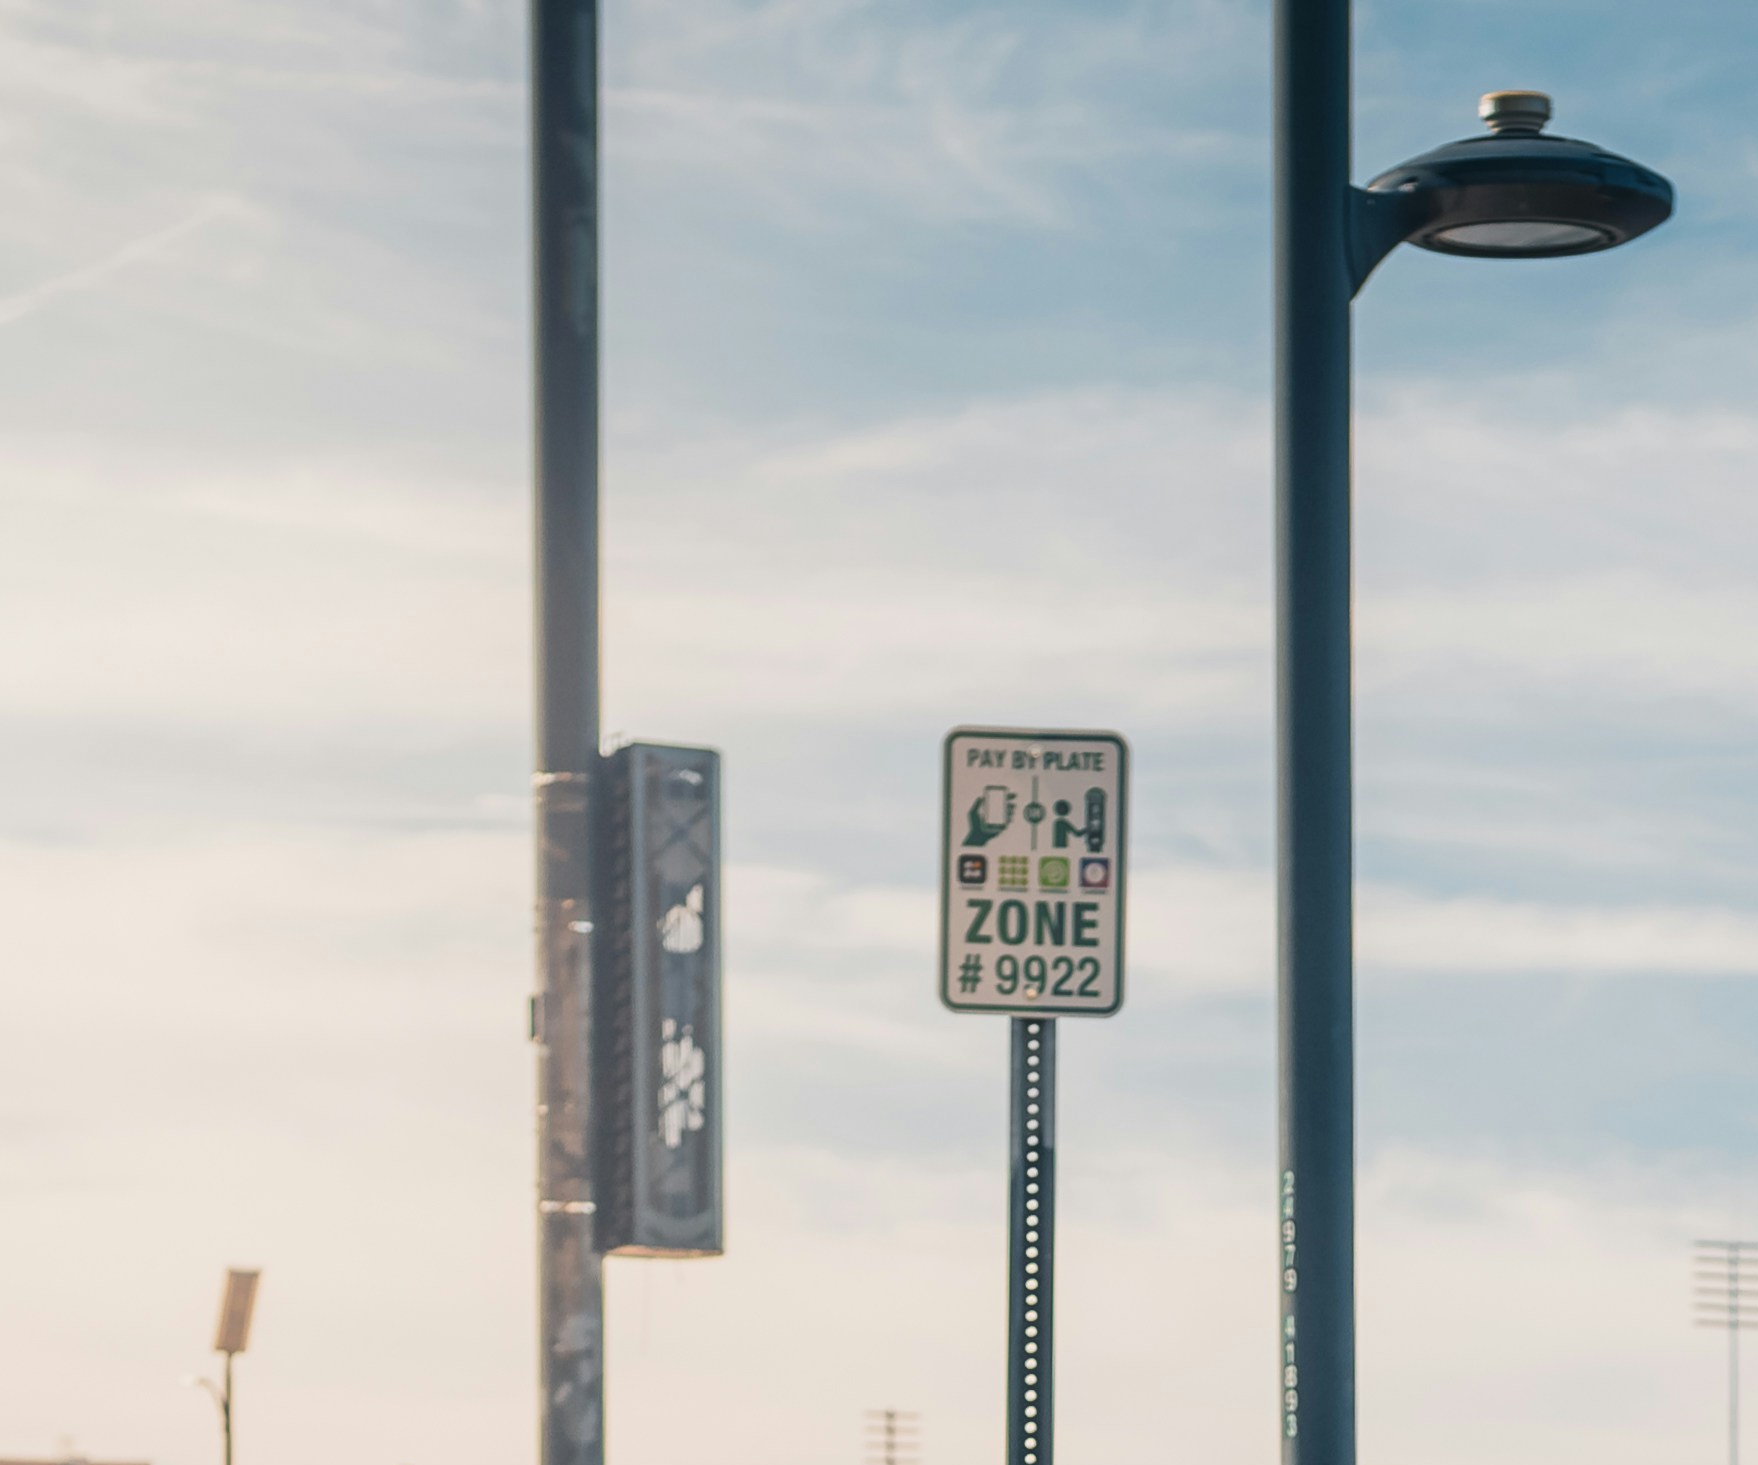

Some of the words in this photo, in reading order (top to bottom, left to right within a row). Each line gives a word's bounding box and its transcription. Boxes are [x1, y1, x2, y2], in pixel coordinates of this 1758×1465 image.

[966, 748, 1006, 768] PAY
[1011, 750, 1036, 769] BY
[1042, 751, 1105, 771] PLATE
[965, 898, 1099, 947] ZONE
[994, 954, 1101, 998] 9922
